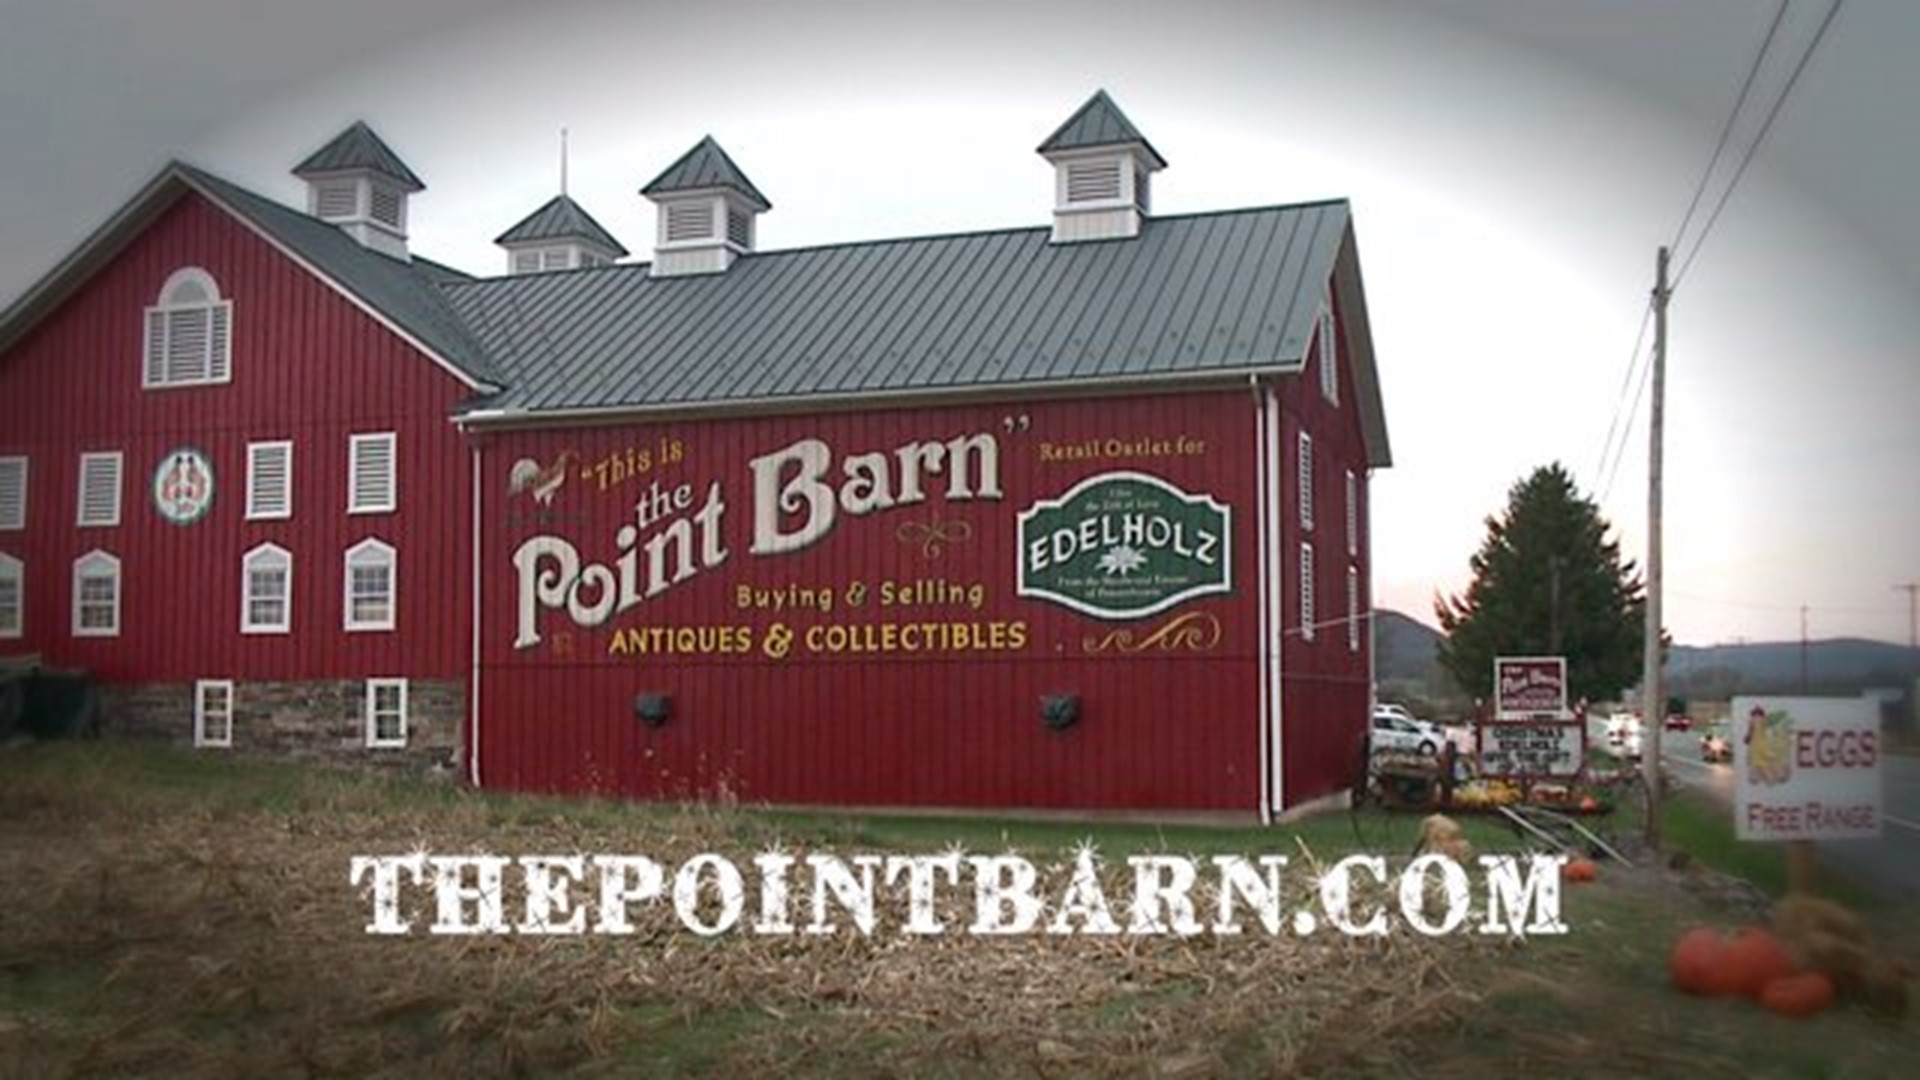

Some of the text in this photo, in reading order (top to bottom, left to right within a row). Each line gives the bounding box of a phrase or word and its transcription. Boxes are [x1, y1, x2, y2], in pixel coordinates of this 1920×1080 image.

[1039, 435, 1206, 461] Retail Outlet for
[635, 481, 694, 529] the
[1030, 512, 1218, 573] EDELHOLZ
[513, 481, 728, 650] Point
[736, 579, 985, 613] Buying & Selling
[608, 621, 1027, 658] ANTIQUES & COLLECTIBLES
[1796, 730, 1877, 769] EGGS
[1748, 802, 1874, 831] FREE RANGE
